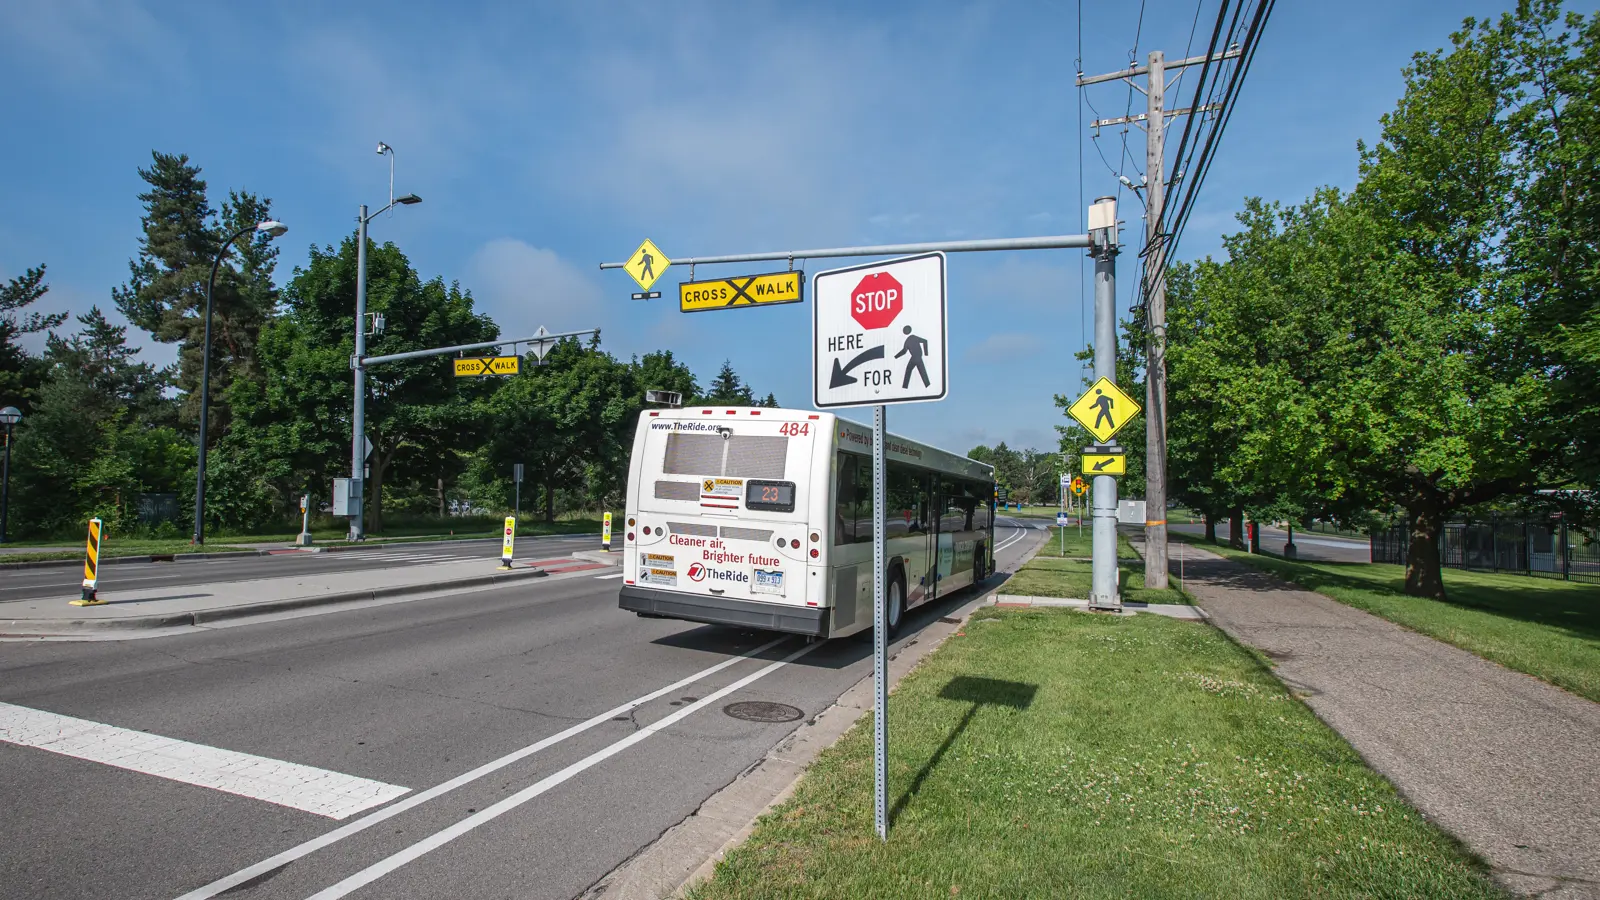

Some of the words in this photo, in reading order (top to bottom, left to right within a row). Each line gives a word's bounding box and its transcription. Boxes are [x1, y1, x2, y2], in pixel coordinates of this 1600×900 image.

[684, 288, 727, 303] CROSS
[755, 281, 794, 296] WALK
[855, 288, 898, 314] STOP
[828, 333, 864, 352] HERE
[456, 363, 480, 372] CROSS
[494, 361, 516, 370] WALK
[864, 369, 892, 387] FOR
[779, 422, 809, 436] 484
[762, 486, 779, 502] 23
[669, 534, 706, 547] Cleaner
[709, 538, 726, 550] air,
[703, 549, 744, 564] Brighter
[748, 553, 780, 566] future
[655, 569, 677, 577] CAUTION
[706, 568, 748, 582] TheRide
